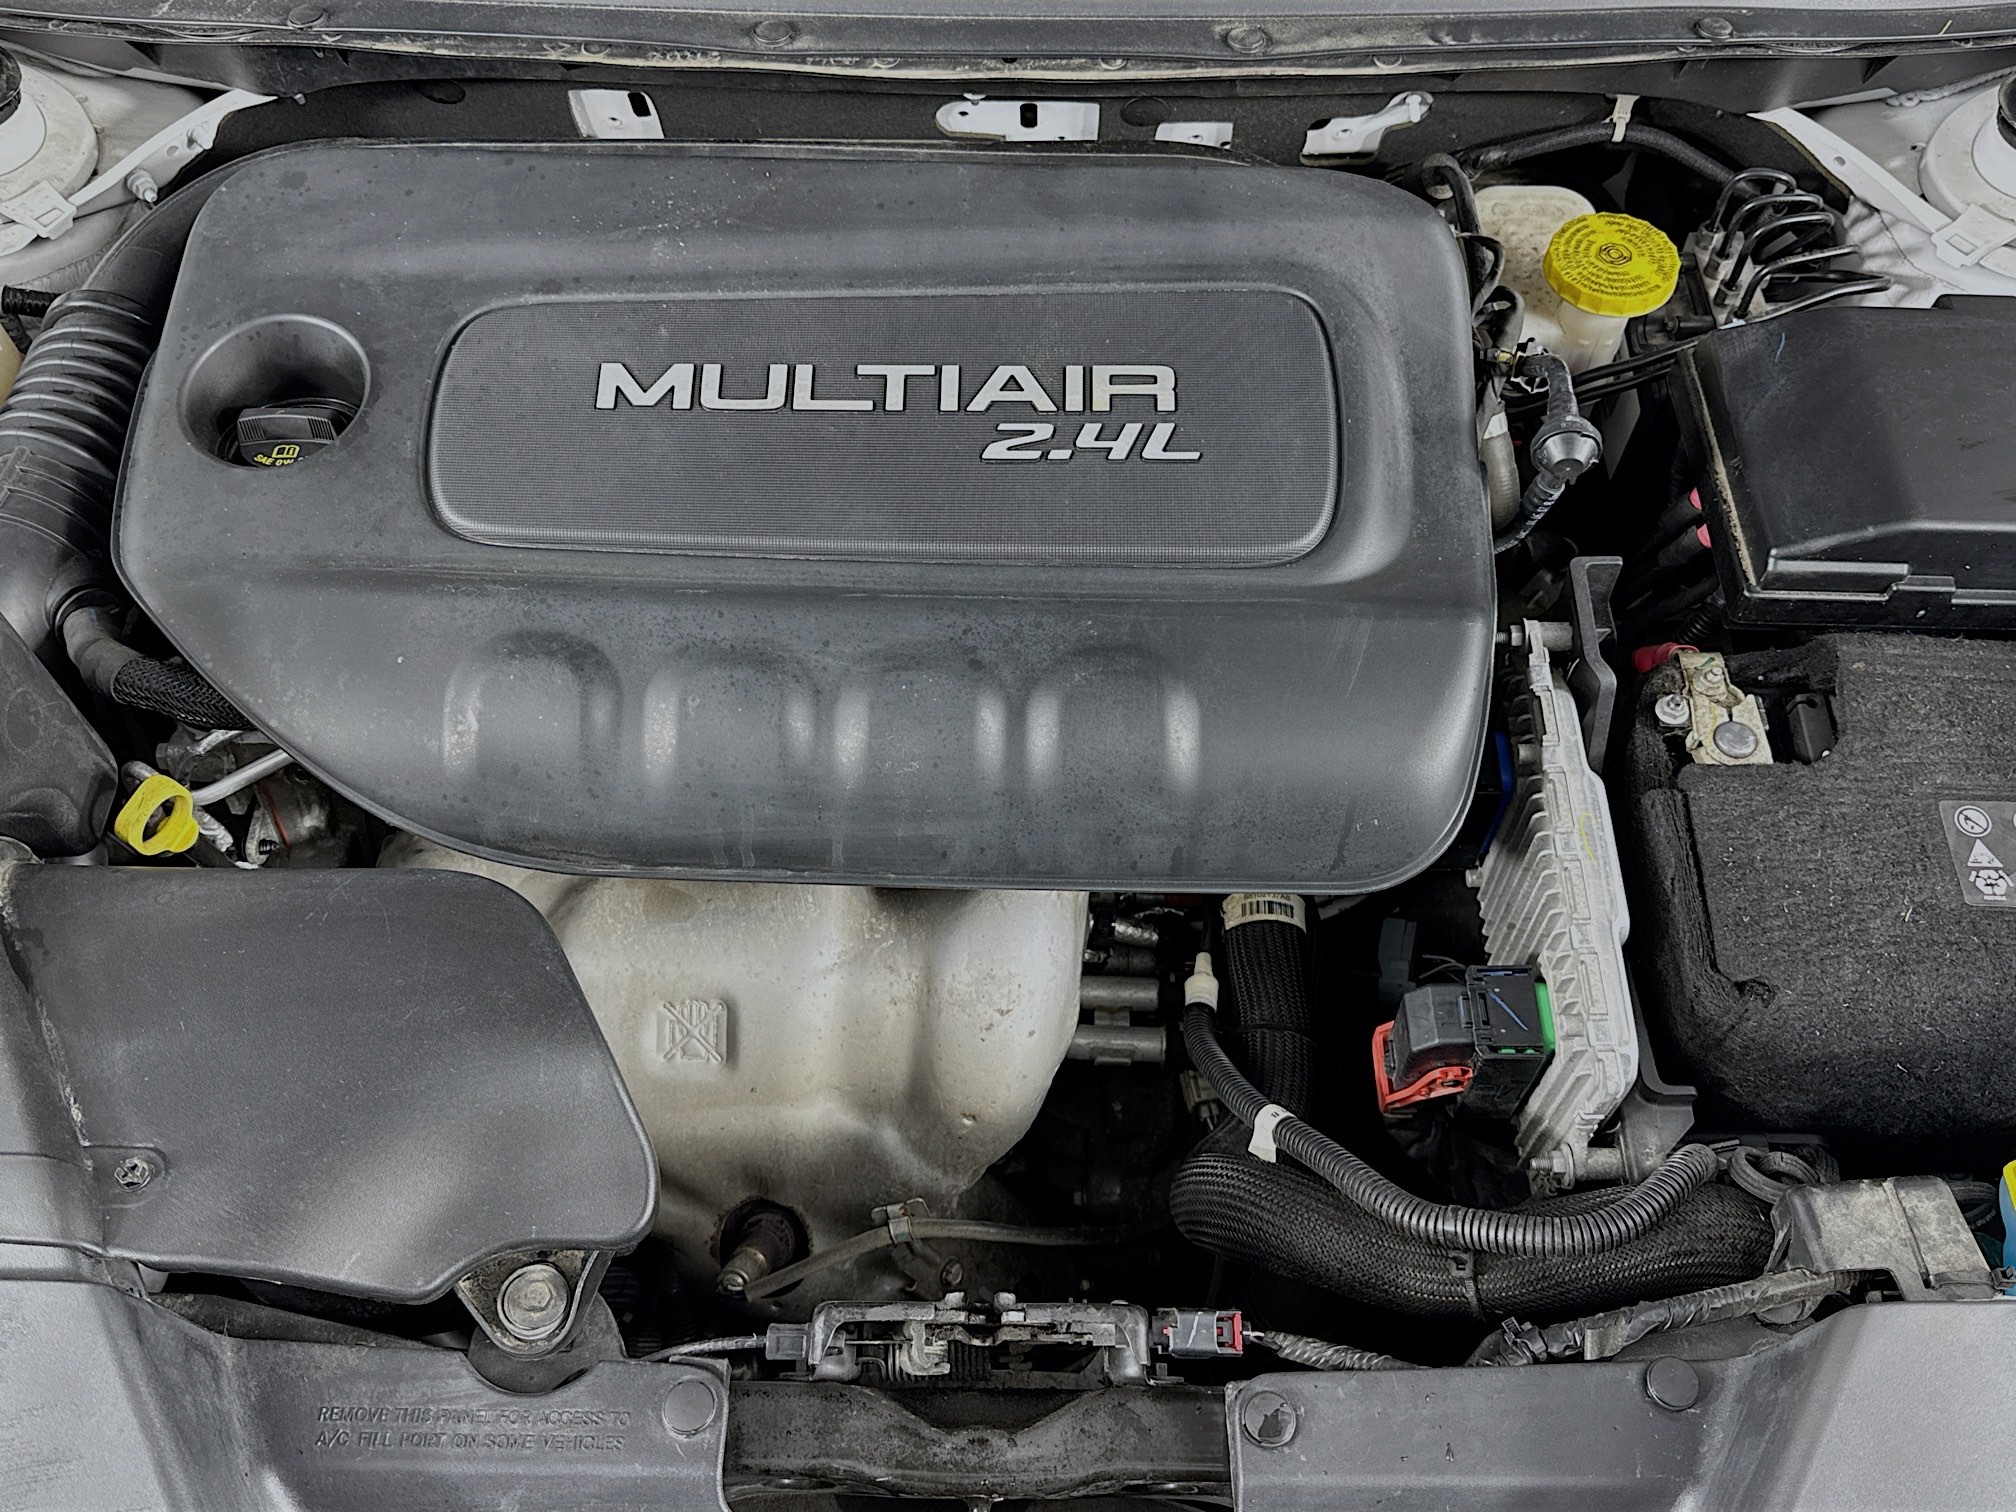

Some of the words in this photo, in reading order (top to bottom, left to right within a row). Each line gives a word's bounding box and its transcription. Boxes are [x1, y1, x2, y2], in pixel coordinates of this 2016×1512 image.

[595, 362, 1176, 413] MULTIAIR
[981, 422, 1201, 461] 2.4L
[254, 455, 275, 466] SAE
[318, 1406, 390, 1423] REMOVE
[395, 1407, 434, 1424] THIS
[438, 1408, 492, 1425] PANEL
[500, 1409, 532, 1426] FOR
[537, 1409, 605, 1427] ACCESS
[609, 1410, 631, 1427] TO
[315, 1428, 350, 1448] A/C
[358, 1431, 393, 1448] FILL
[400, 1432, 448, 1448] PORT
[453, 1433, 480, 1449] ON
[484, 1434, 535, 1450] SOME
[541, 1434, 625, 1451] VEHICLES
